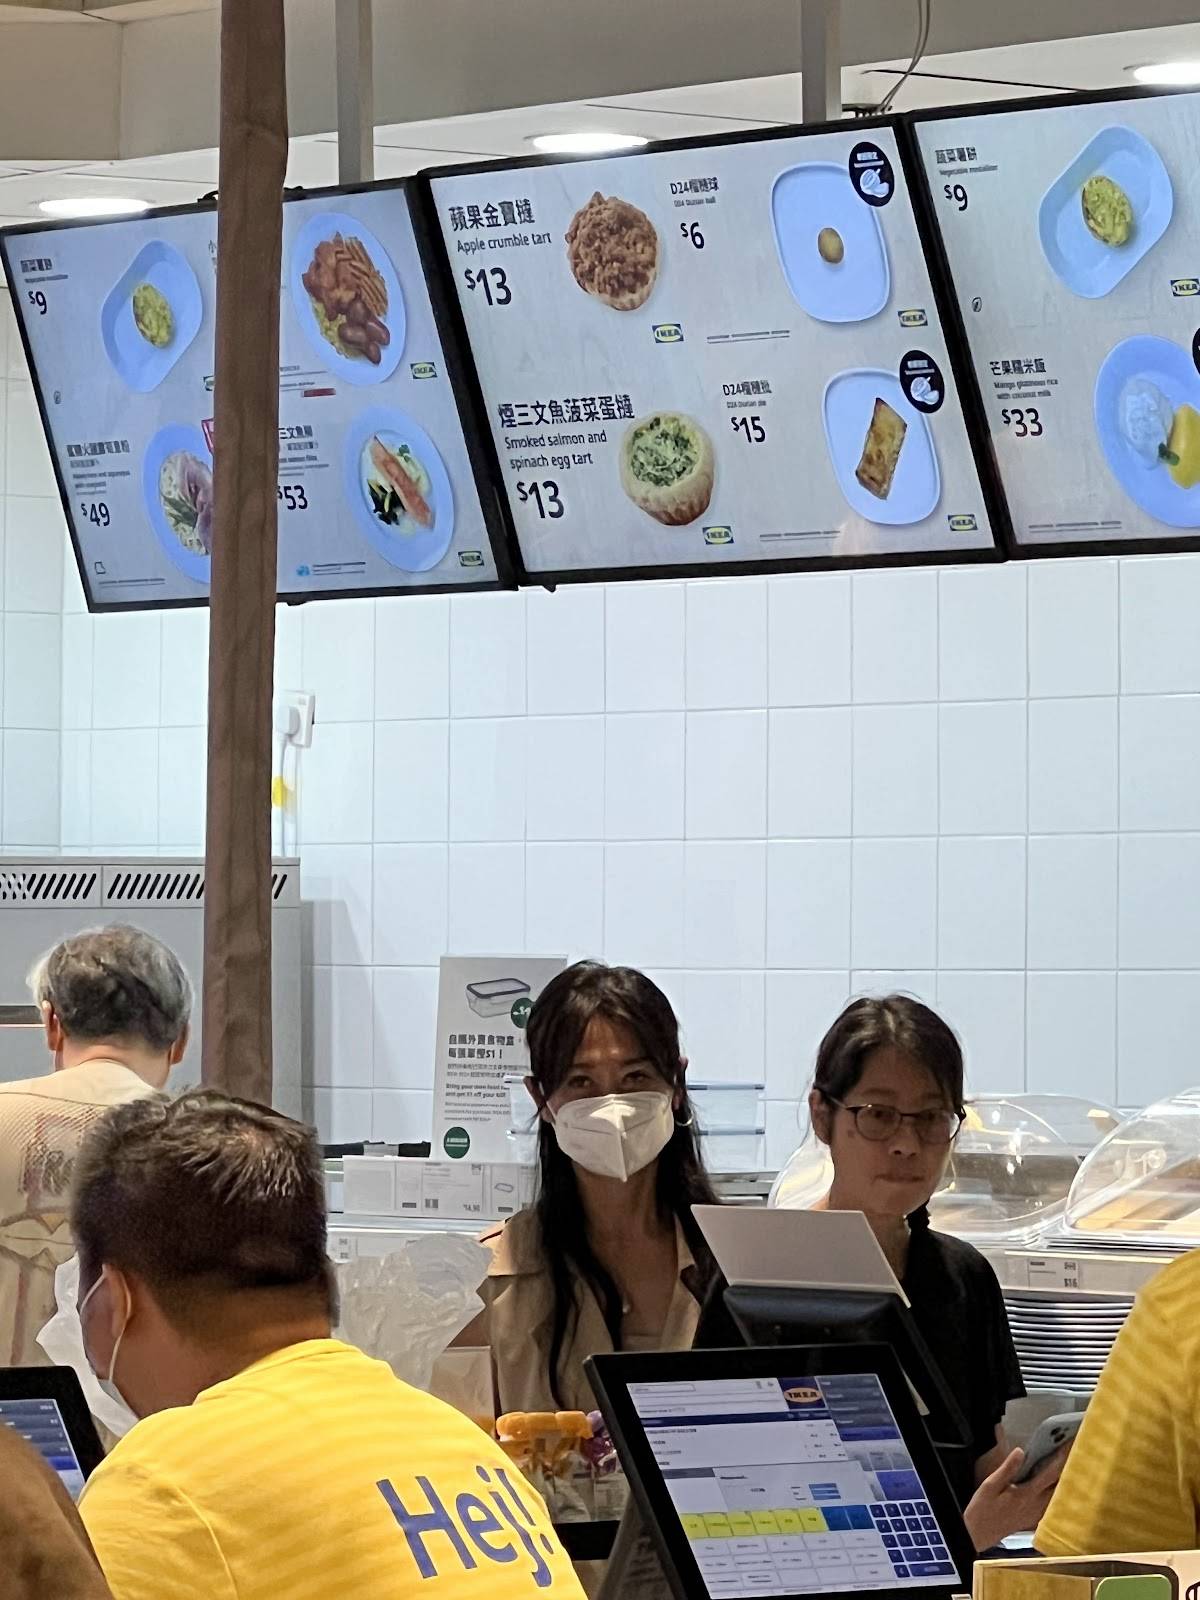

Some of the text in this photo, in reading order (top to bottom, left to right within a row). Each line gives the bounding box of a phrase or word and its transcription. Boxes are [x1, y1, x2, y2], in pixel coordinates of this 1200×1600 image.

[943, 183, 968, 211] $9
[457, 232, 552, 255] Apple crumble tart
[680, 222, 705, 249] $6
[464, 267, 512, 306] $13
[28, 291, 47, 315] $9
[731, 416, 766, 443] $15
[1001, 407, 1043, 437] $33
[505, 430, 607, 449] Smoked salmon and
[510, 453, 593, 472] spinach egg tart
[516, 480, 564, 519] $13
[81, 502, 111, 527] $49
[376, 1465, 554, 1588] Hej!
